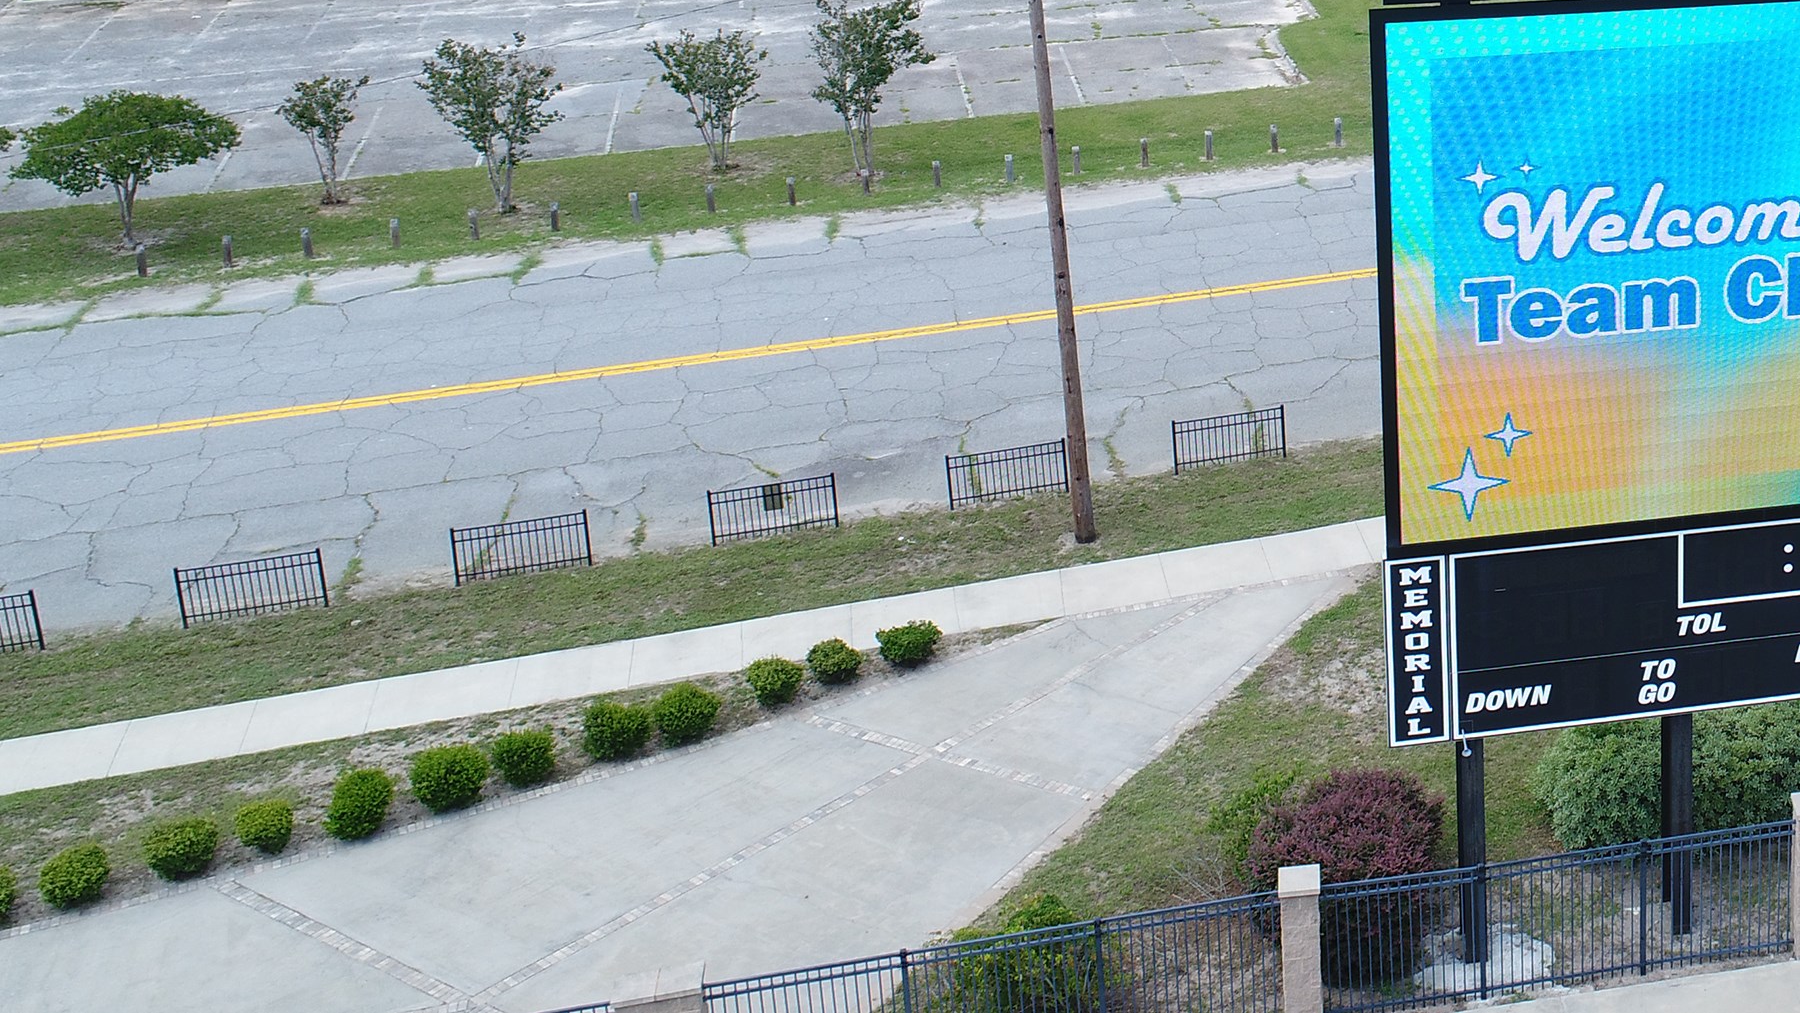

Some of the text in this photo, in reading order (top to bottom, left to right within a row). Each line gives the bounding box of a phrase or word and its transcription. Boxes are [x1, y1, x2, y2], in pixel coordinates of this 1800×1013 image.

[1461, 275, 1700, 347] Team
[1676, 612, 1727, 636] TOL
[1399, 565, 1433, 737] MEMORIAL
[1640, 658, 1676, 682] TO
[1466, 684, 1552, 714] DOWN
[1638, 682, 1676, 705] GO
